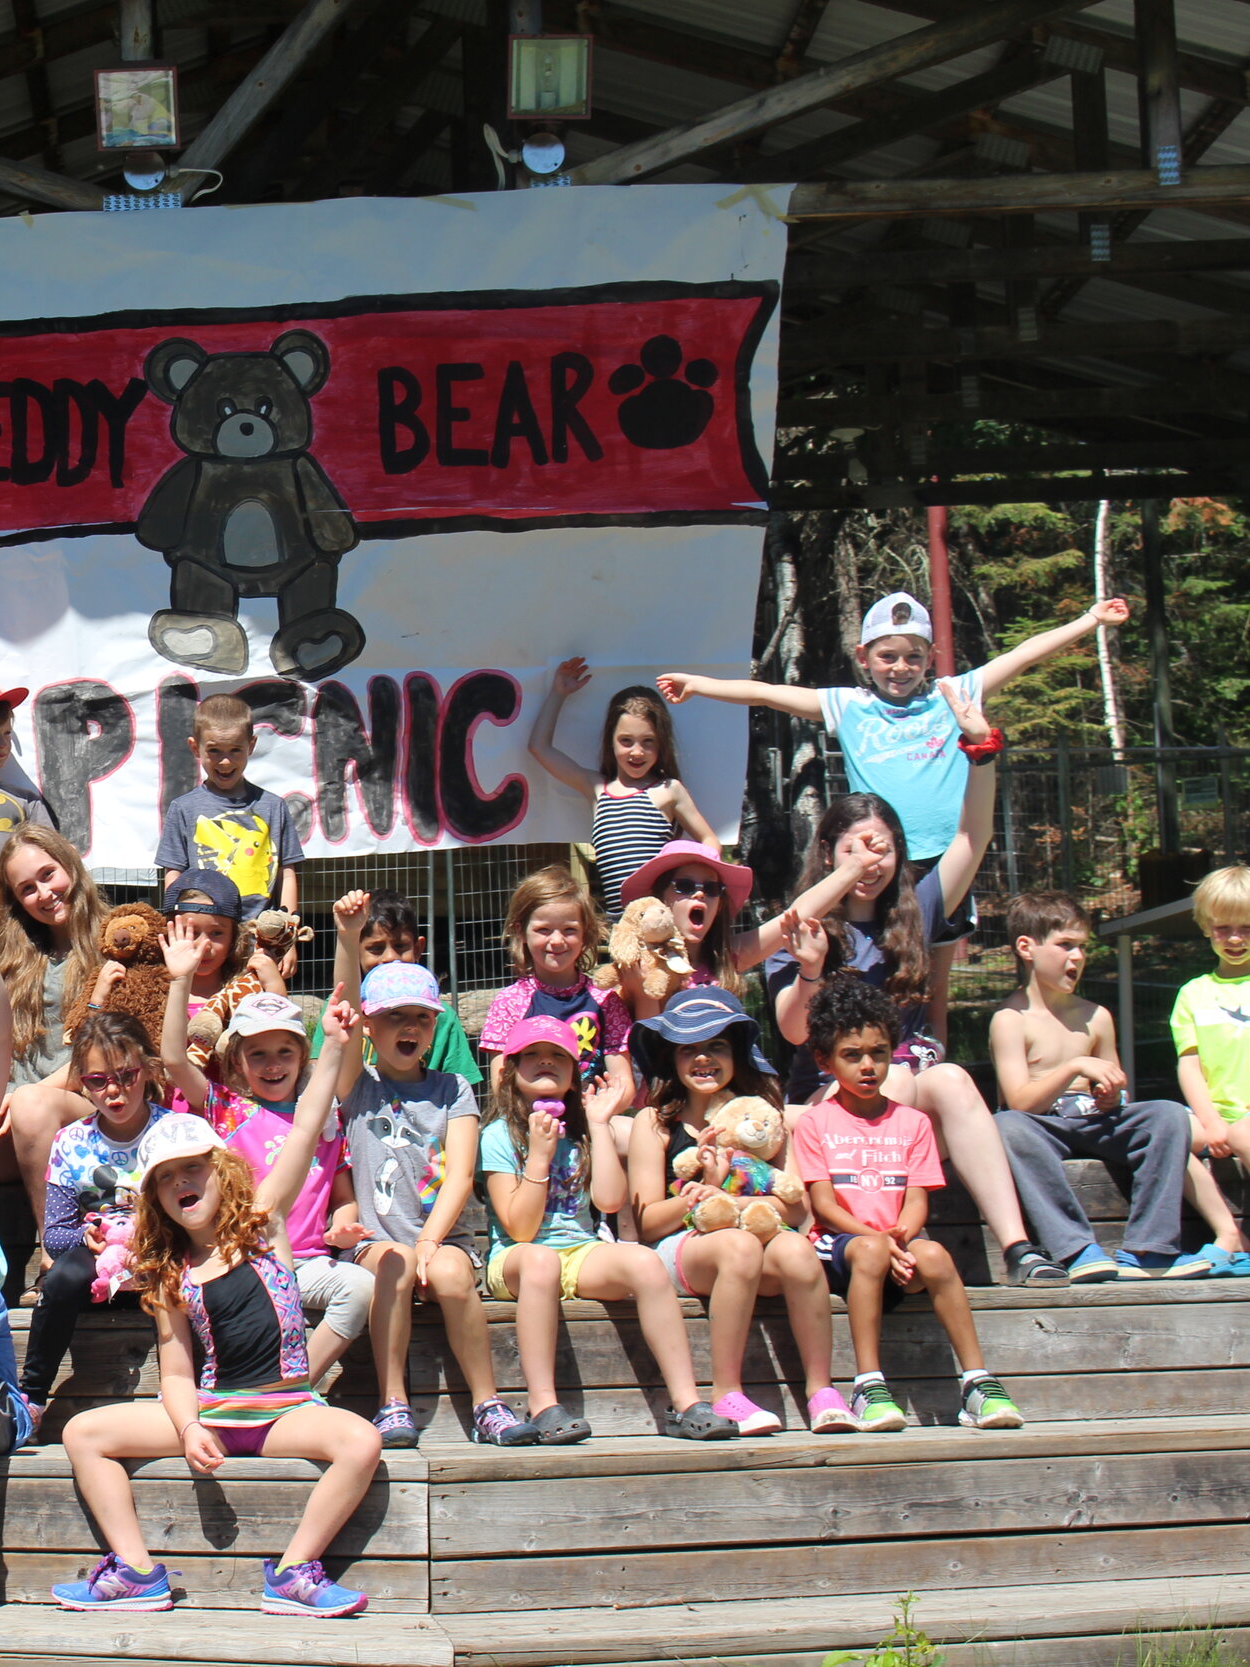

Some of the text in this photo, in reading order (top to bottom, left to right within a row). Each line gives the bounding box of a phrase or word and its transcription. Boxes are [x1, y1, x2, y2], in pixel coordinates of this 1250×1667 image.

[378, 352, 602, 475] BEAR
[855, 709, 953, 757] Roots
[861, 1149, 902, 1167] Fitch
[860, 1175, 880, 1187] NY
[884, 1176, 896, 1185] 92
